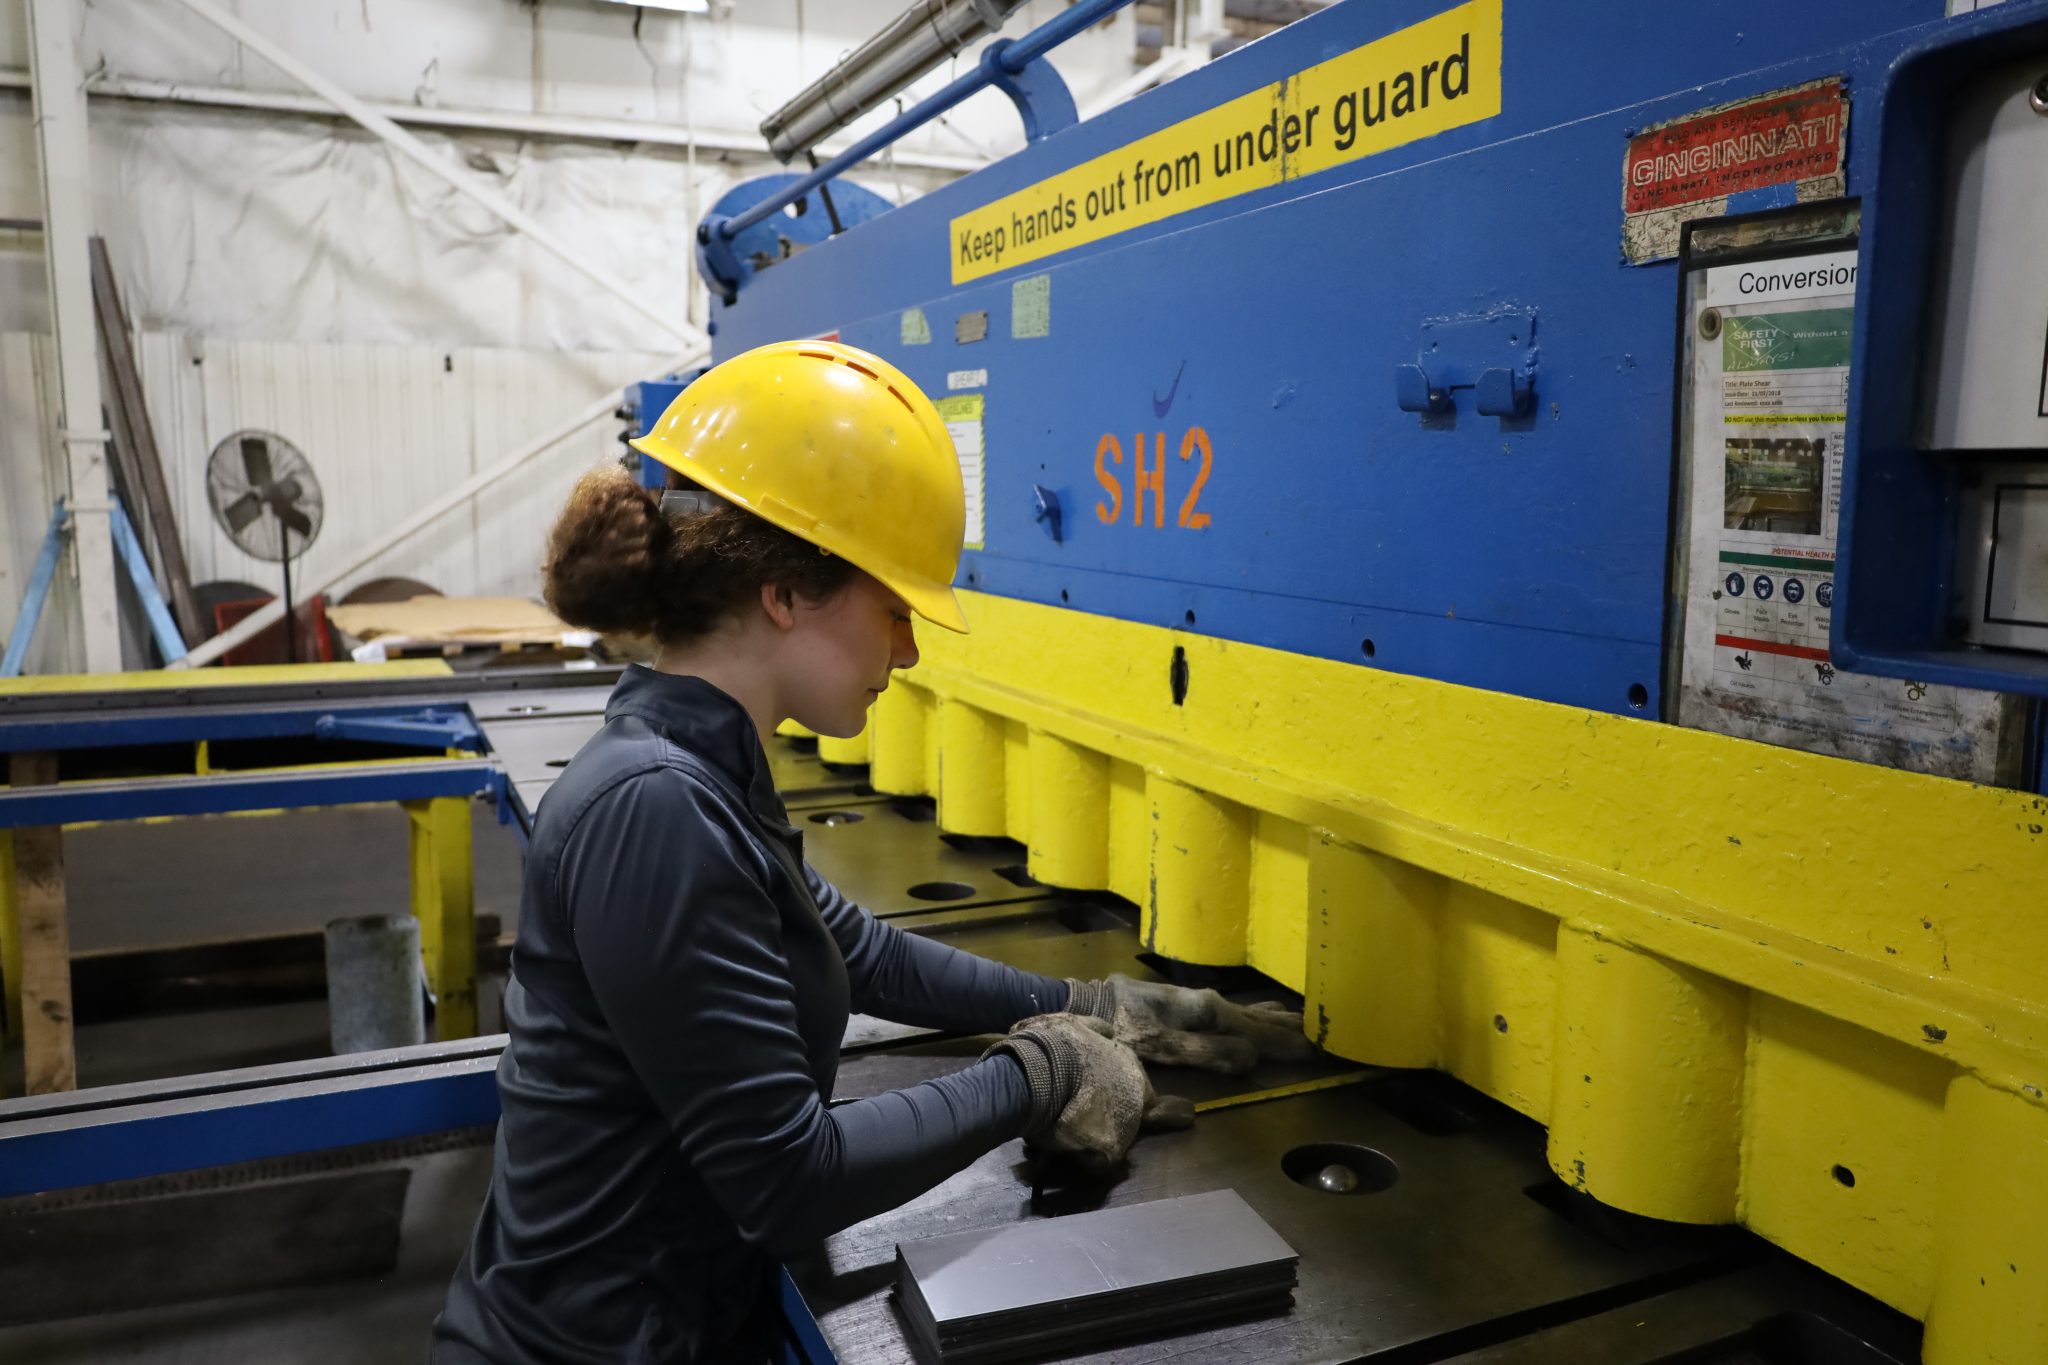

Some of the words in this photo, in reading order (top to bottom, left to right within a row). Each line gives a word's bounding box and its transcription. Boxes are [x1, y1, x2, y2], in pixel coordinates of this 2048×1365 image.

[1694, 122, 1717, 136] AND
[960, 226, 1006, 264] Keep
[1012, 193, 1077, 248] hands
[1085, 171, 1126, 221] out
[1133, 150, 1201, 205] from
[1213, 105, 1320, 178] under
[1333, 32, 1470, 152] guard
[1632, 114, 1836, 186] CINCINNATI
[1632, 179, 1710, 201] CINCINNATI
[1716, 151, 1834, 183] INCORPORATED
[1733, 328, 1779, 340] SAFETY
[1792, 330, 1838, 339] Without
[1740, 338, 1775, 349] FIRST
[1808, 415, 1819, 423] you
[1094, 426, 1213, 529] SH2
[1772, 547, 1804, 557] POTENTIAL
[1805, 550, 1830, 558] HEALTH
